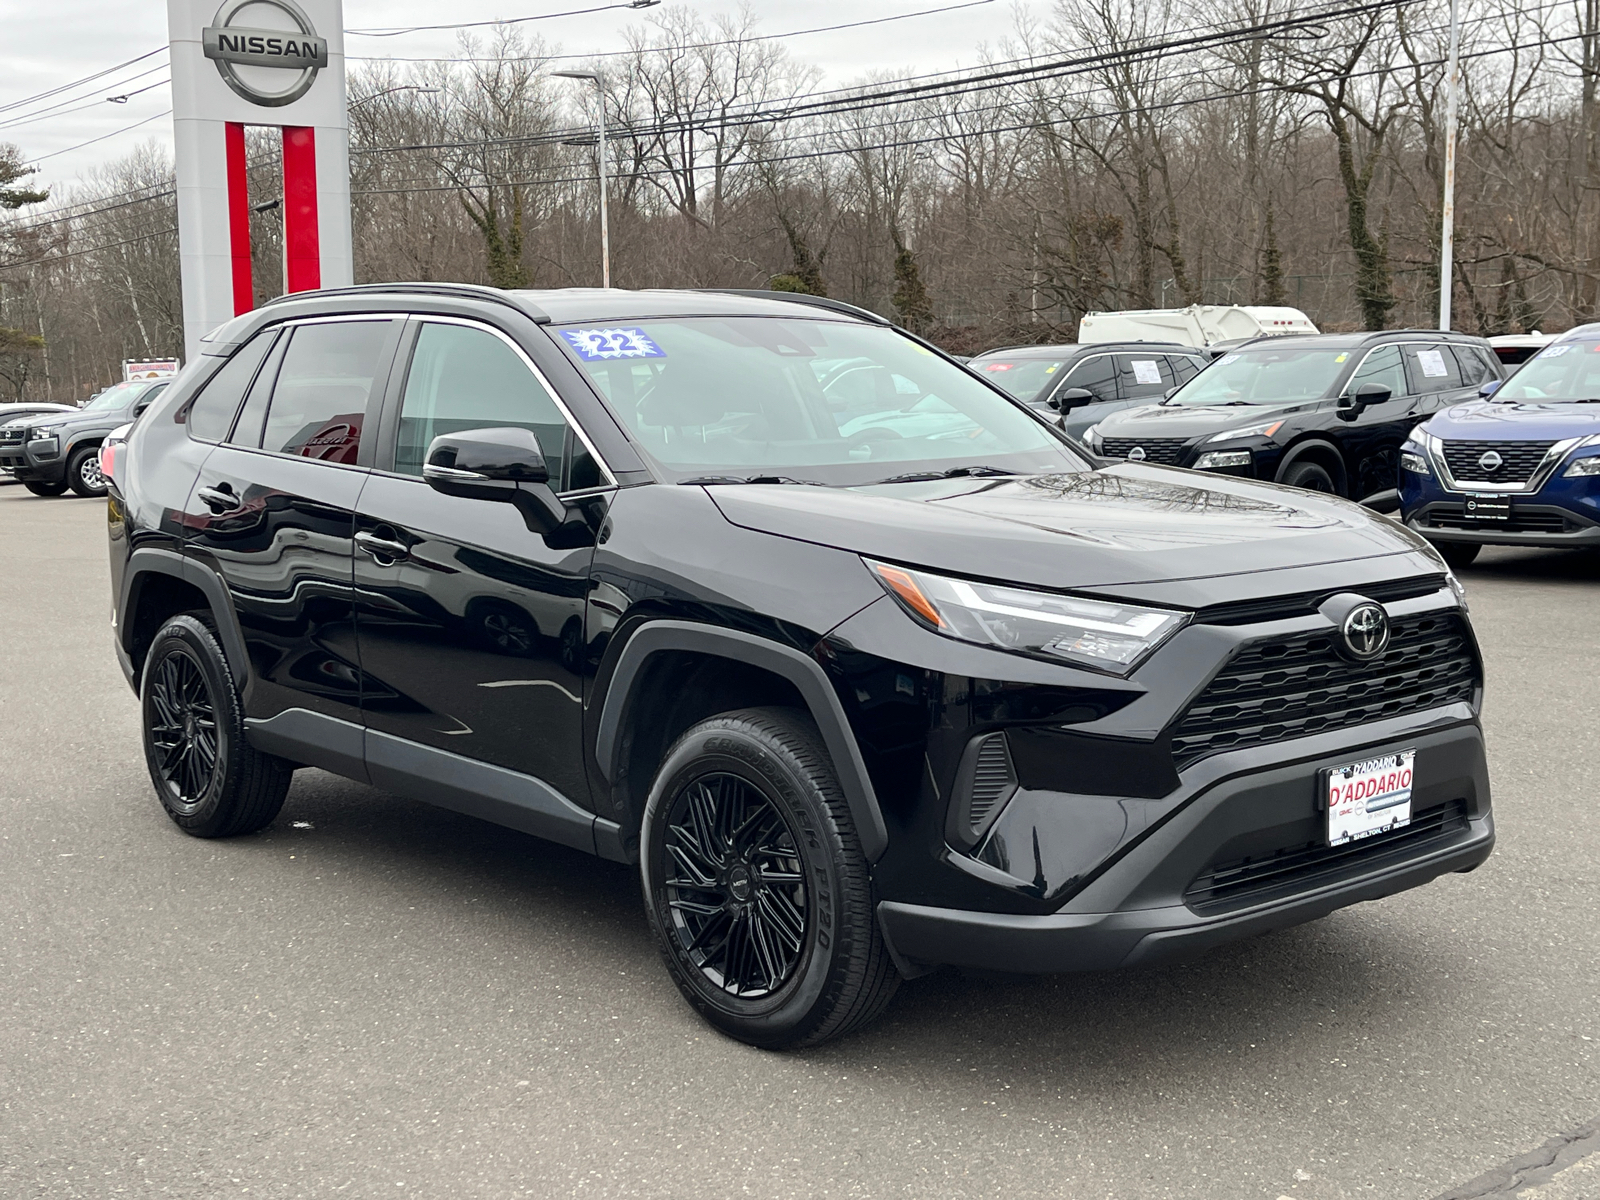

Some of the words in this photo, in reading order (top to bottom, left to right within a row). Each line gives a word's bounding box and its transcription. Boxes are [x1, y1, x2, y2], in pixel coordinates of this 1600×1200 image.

[218, 34, 318, 60] NISSAN
[588, 334, 638, 352] 22
[1353, 755, 1397, 775] D'ADDARIO
[1329, 768, 1412, 808] D'ADDARIO
[1382, 824, 1391, 833] CT
[813, 865, 833, 951] PT20
